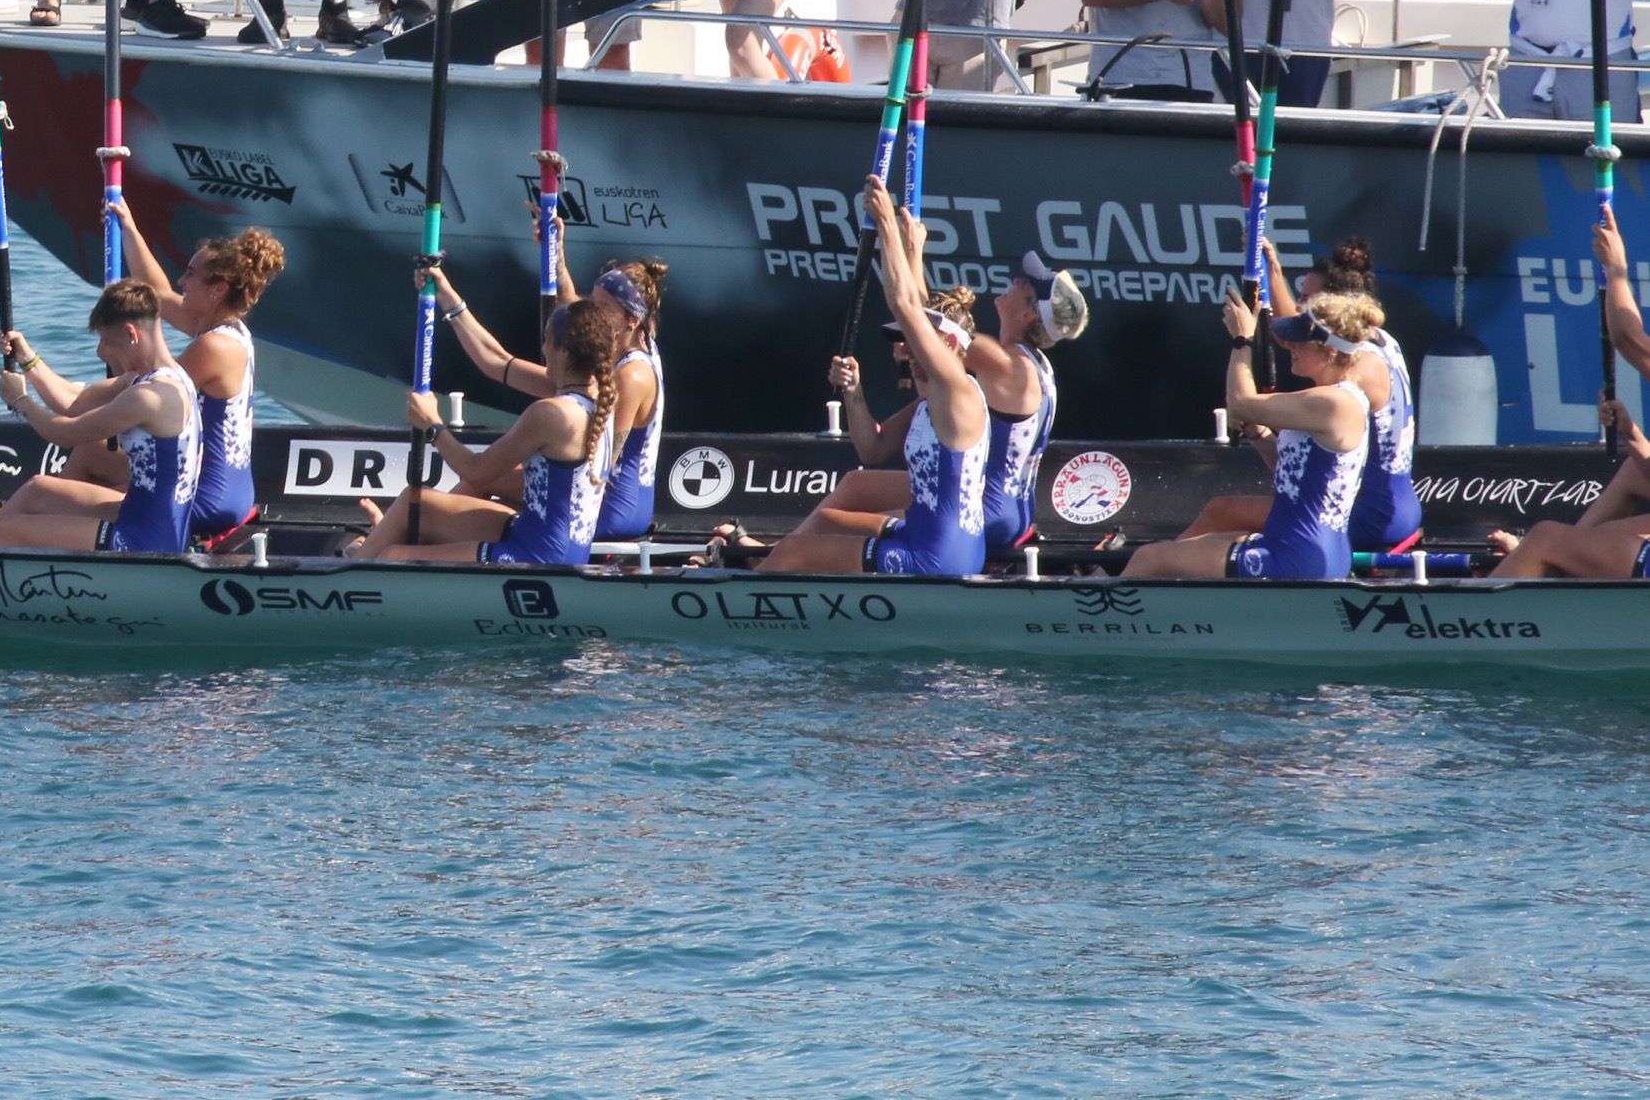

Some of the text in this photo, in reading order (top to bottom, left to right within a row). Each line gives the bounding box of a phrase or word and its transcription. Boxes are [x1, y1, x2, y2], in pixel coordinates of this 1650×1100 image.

[214, 160, 287, 188] LIGA
[593, 186, 660, 199] euskotren
[601, 202, 668, 229] LIGA
[1036, 200, 1314, 268] GAUDE
[421, 325, 434, 386] CaixaBank
[256, 587, 383, 611] SMF
[671, 591, 896, 622] OLATXO
[1025, 623, 1215, 634] BERRILAN
[1405, 603, 1541, 639] elektra
